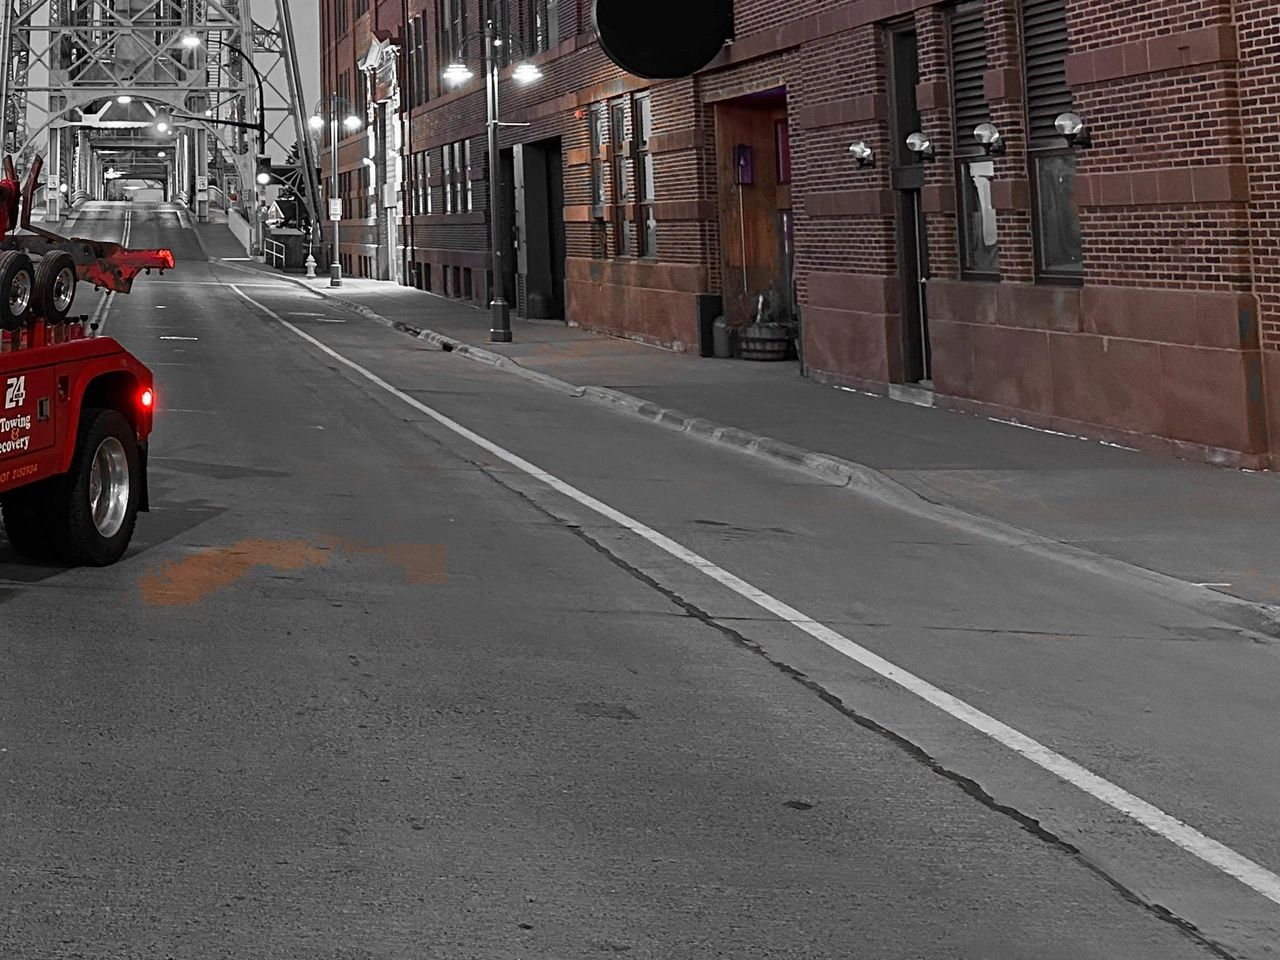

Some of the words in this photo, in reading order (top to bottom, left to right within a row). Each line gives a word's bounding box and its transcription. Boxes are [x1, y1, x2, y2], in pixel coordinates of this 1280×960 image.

[5, 375, 25, 409] 24
[0, 414, 31, 433] Towing
[11, 427, 19, 440] &
